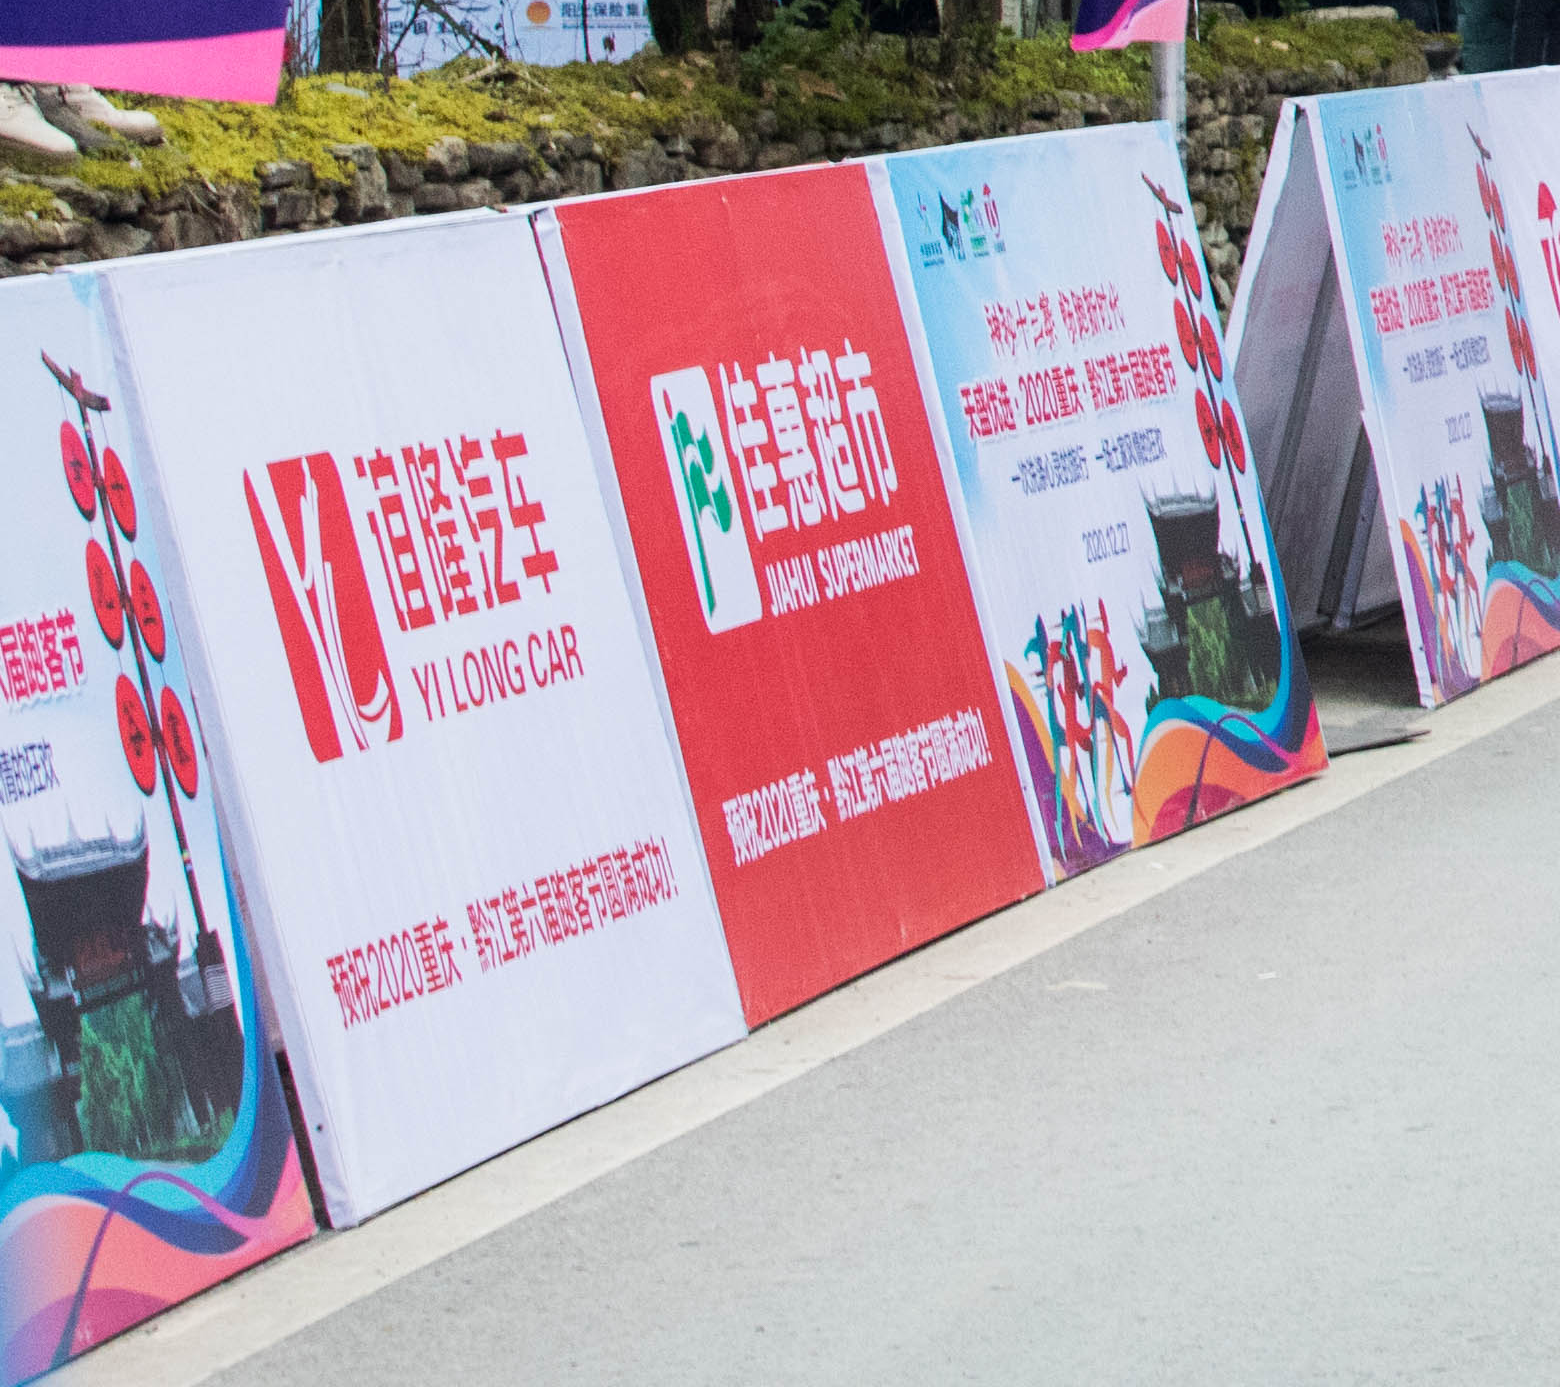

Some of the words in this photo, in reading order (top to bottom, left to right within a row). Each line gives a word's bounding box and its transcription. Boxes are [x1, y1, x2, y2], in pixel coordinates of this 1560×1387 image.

[717, 336, 899, 544] 佳惠超市
[959, 341, 1177, 440] 天盛优选·2020重庆·黔江第六届跑客节
[356, 430, 561, 632] 谊隆汽车
[767, 563, 818, 617] JIAHUI
[819, 524, 920, 604] SUPERMARKET
[411, 658, 447, 722] YI
[452, 640, 527, 715] LONG
[527, 622, 586, 690] CAR
